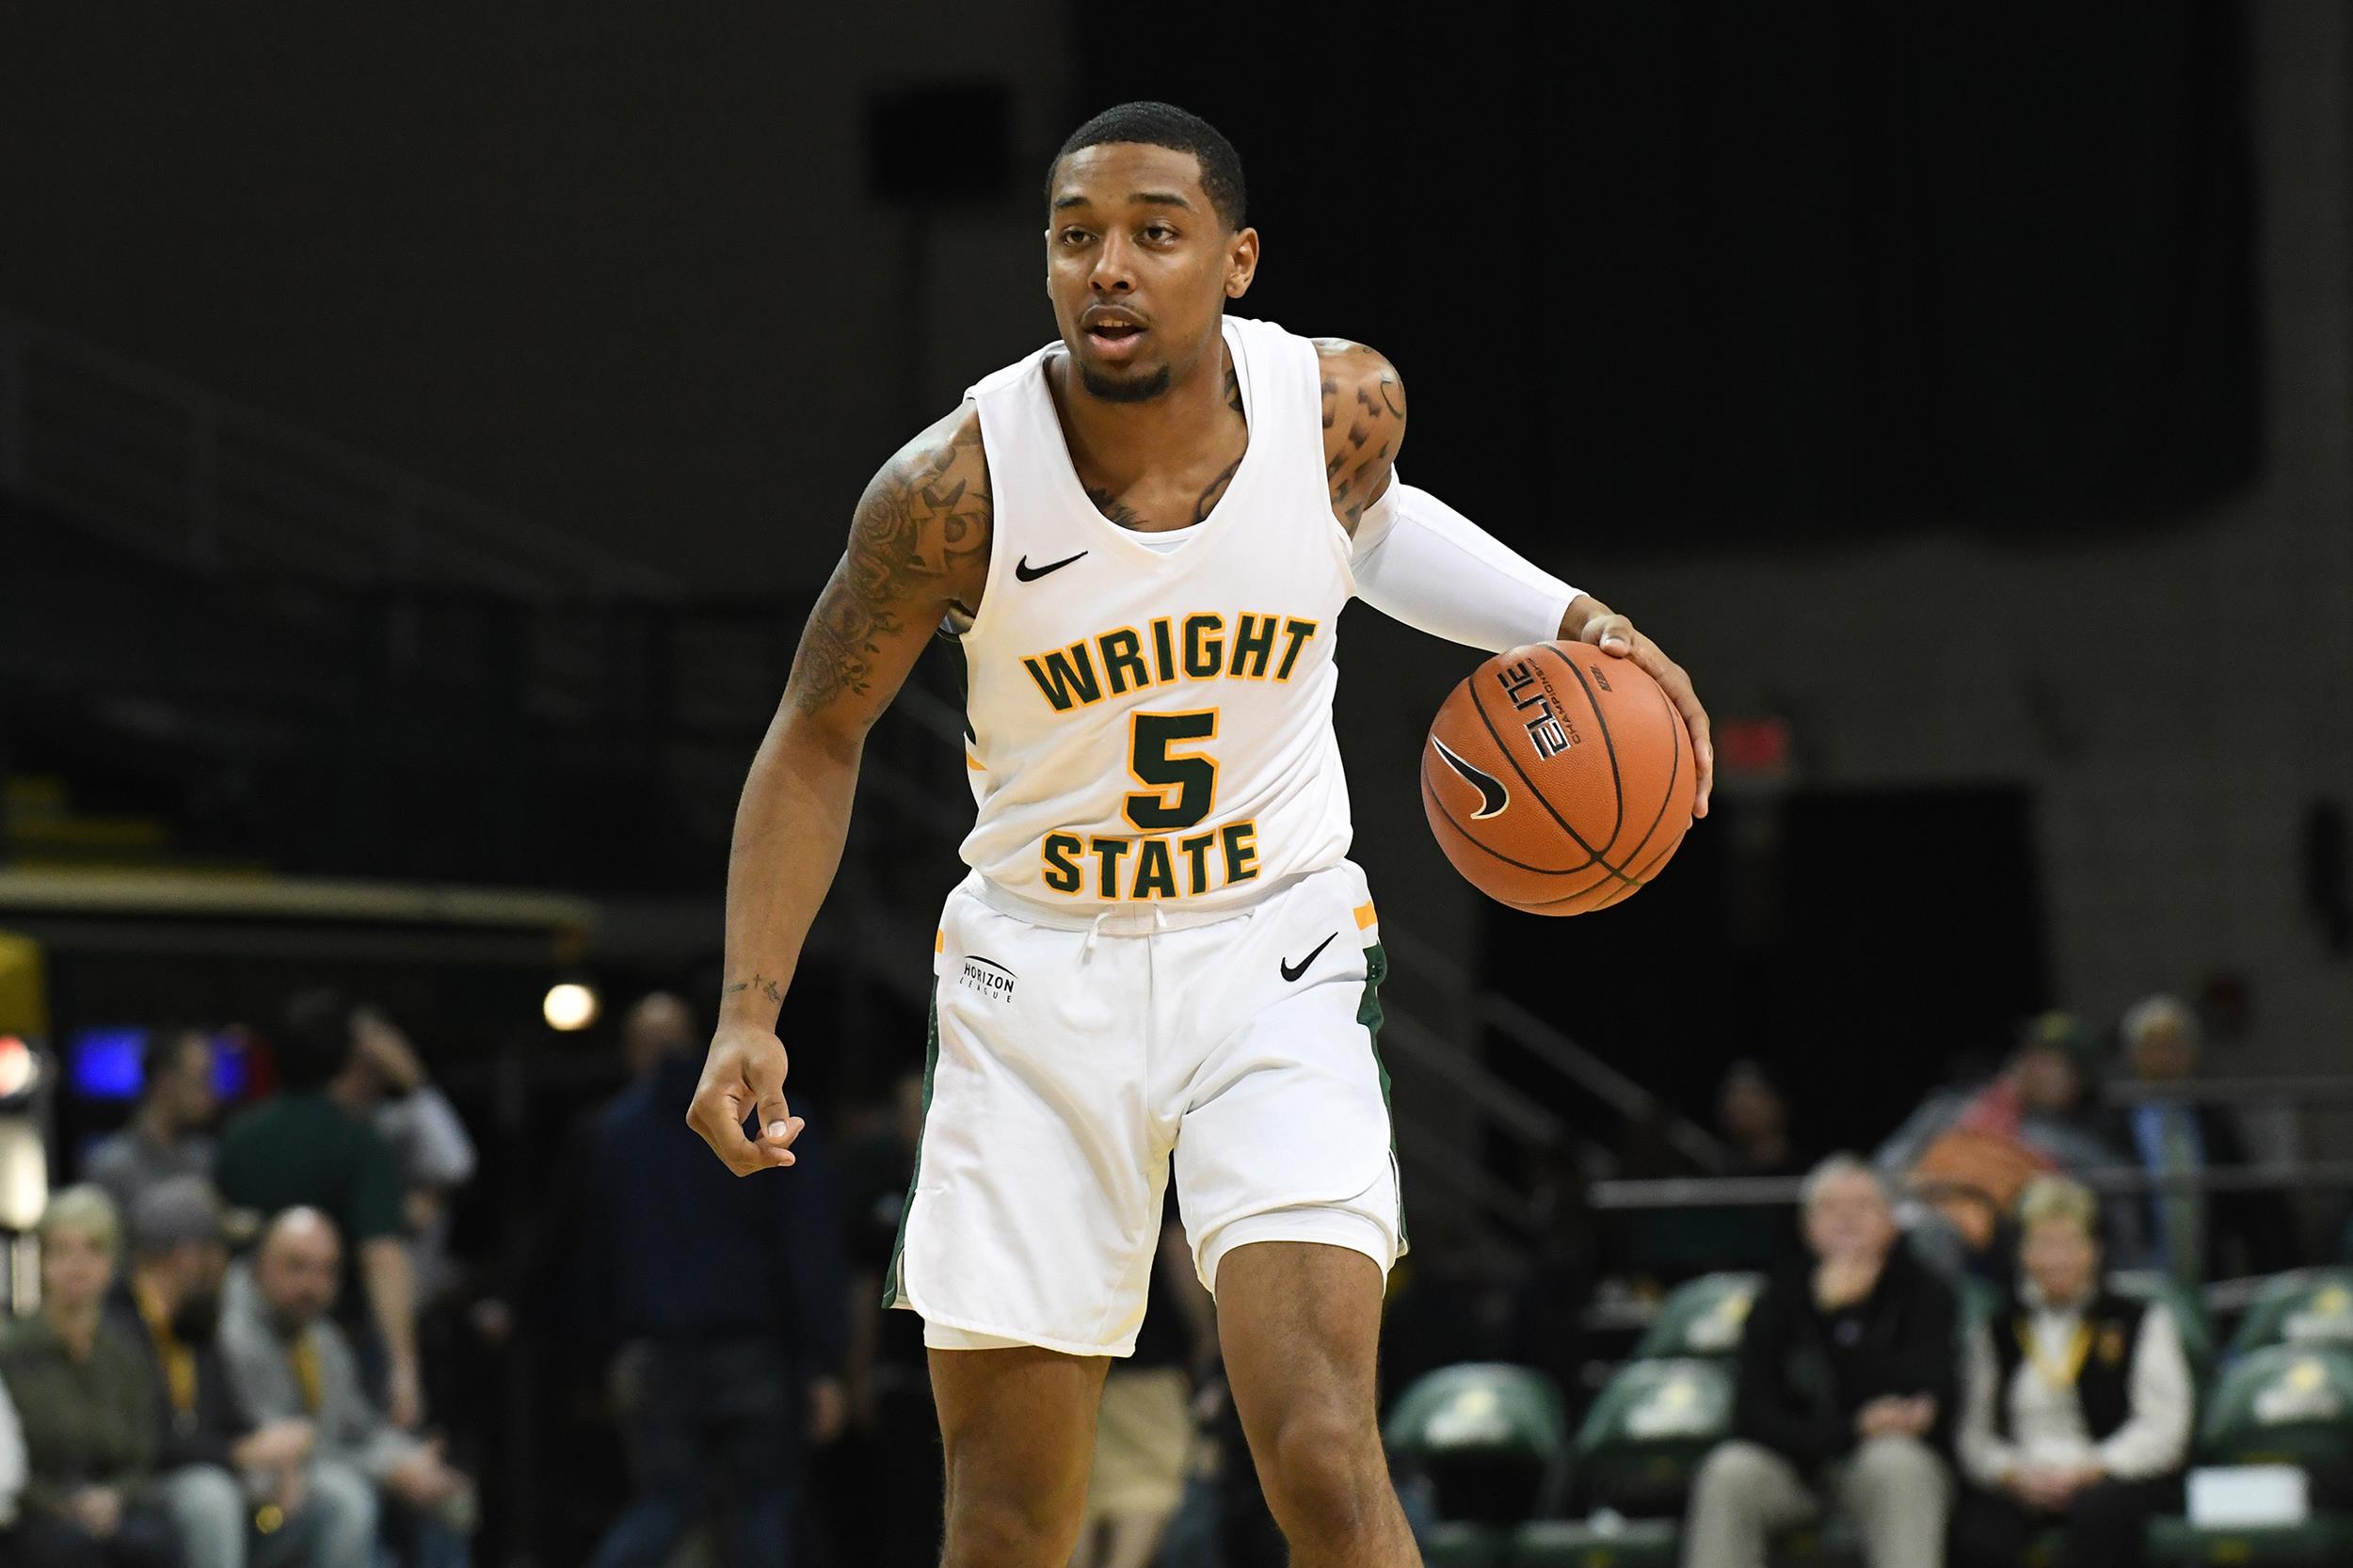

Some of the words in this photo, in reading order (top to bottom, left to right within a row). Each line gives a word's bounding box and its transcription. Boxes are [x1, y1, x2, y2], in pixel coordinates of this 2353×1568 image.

[1019, 612, 1320, 714] WRIGHT
[1497, 661, 1572, 761] ELITE
[1121, 707, 1220, 831] 5
[1041, 818, 1262, 902] STATE
[959, 976, 1012, 1003] LEAGUE
[963, 962, 1015, 993] HORIZON
